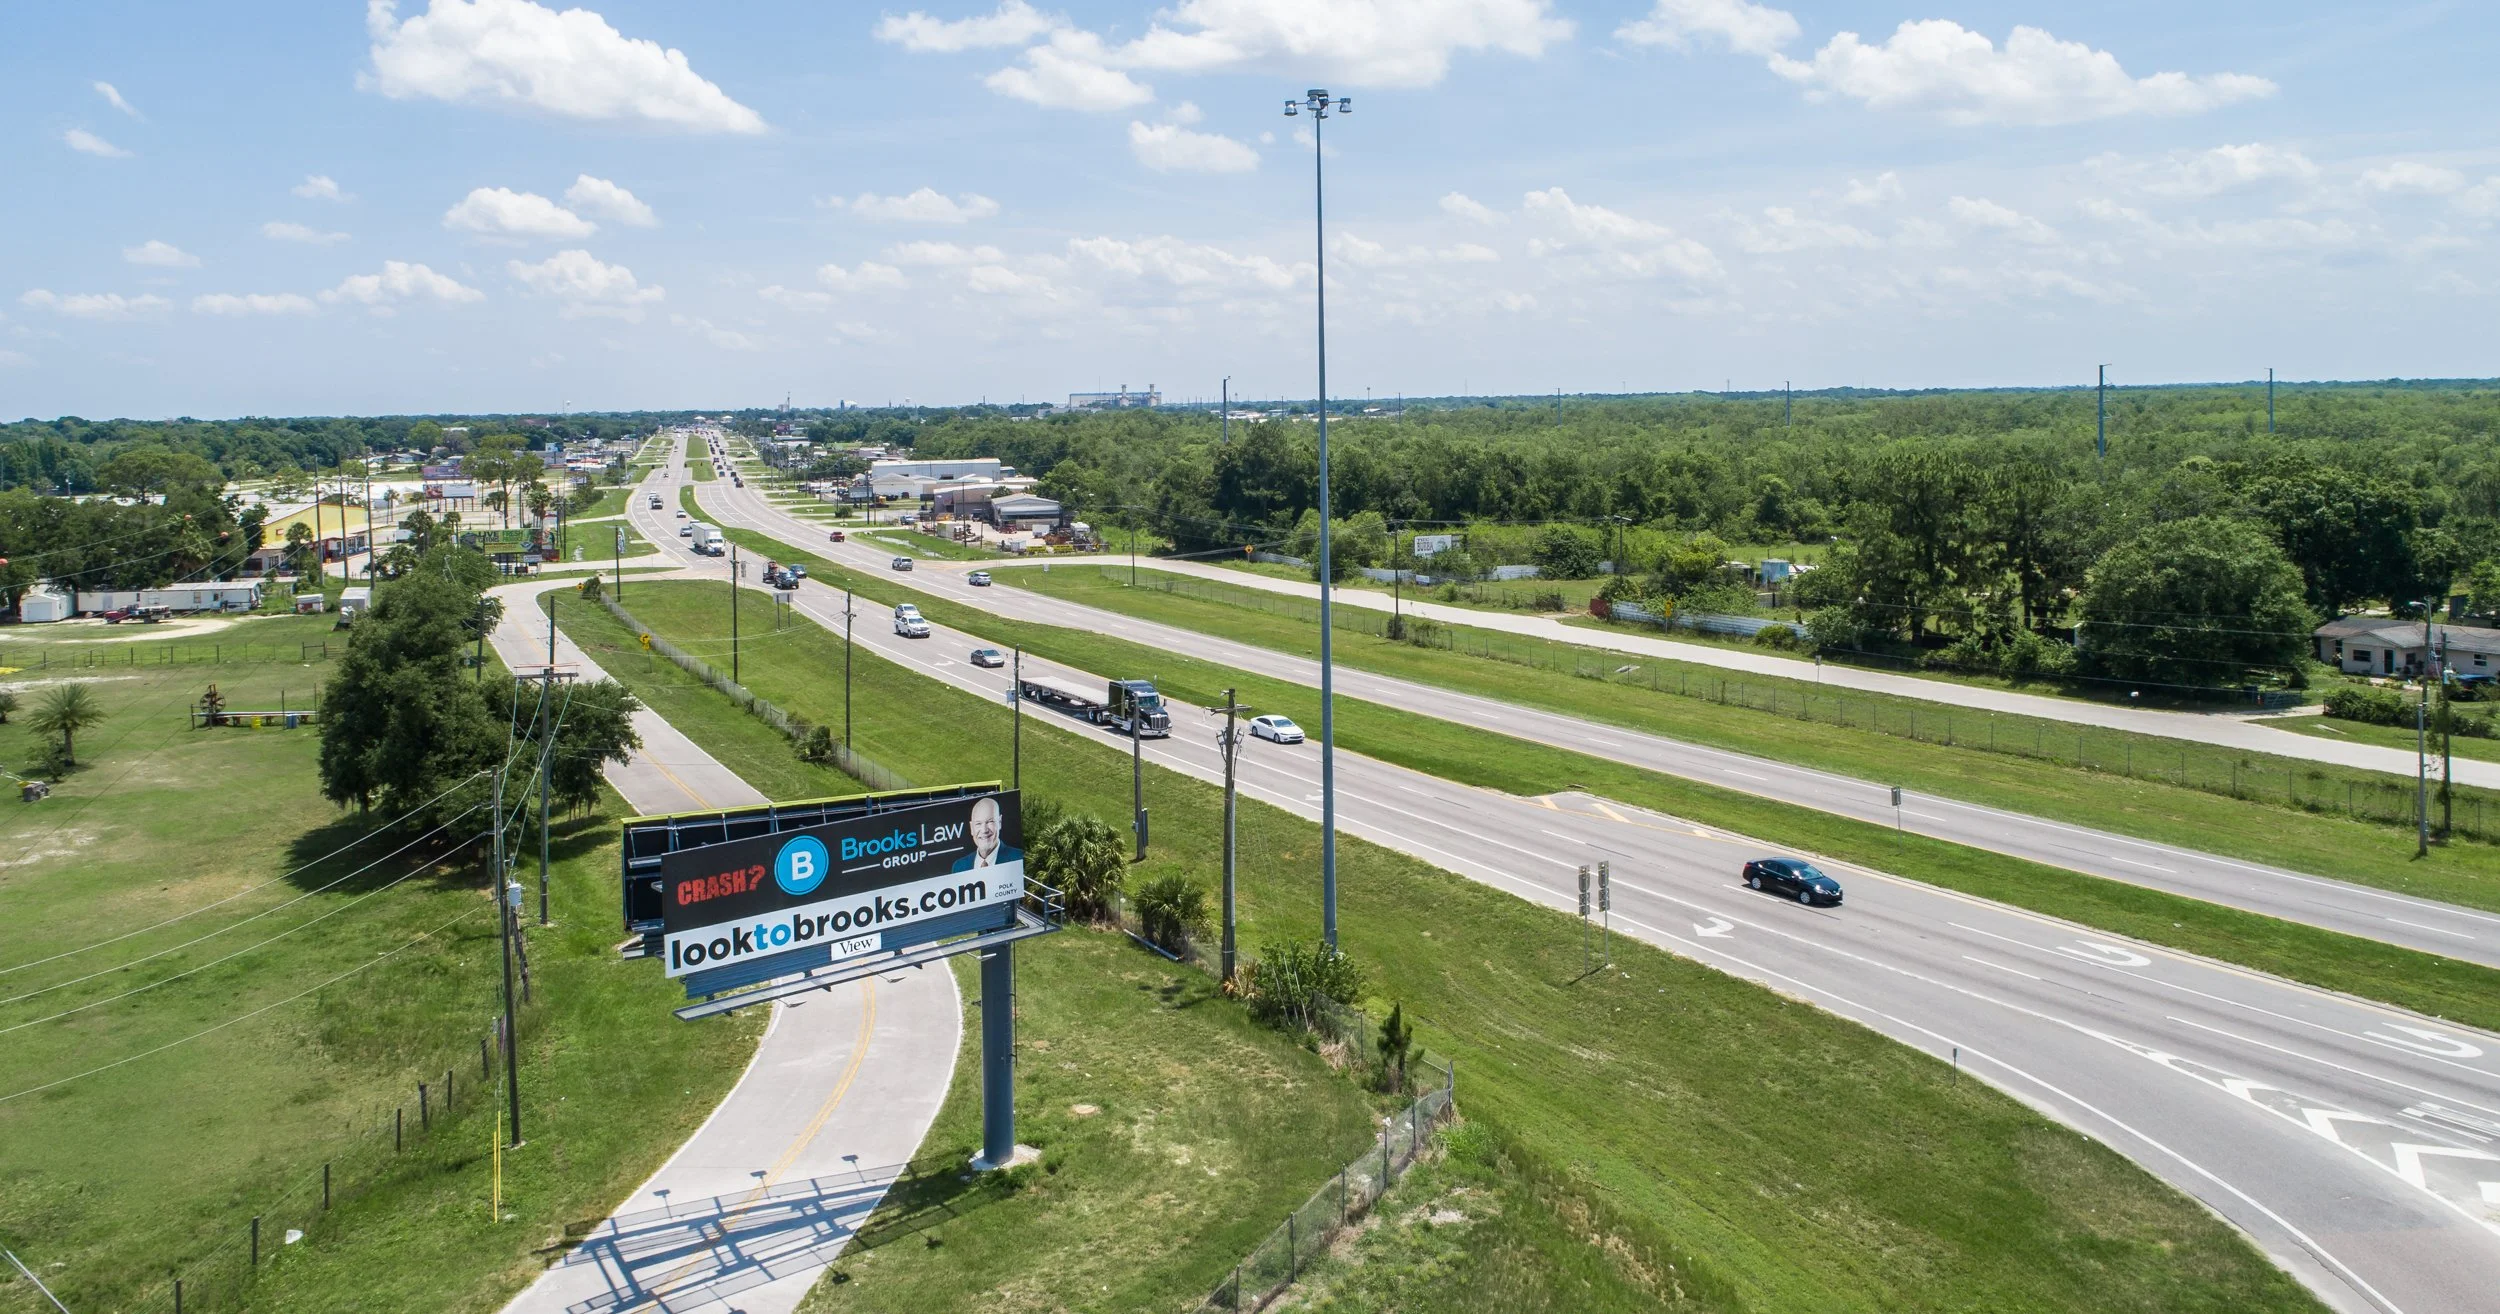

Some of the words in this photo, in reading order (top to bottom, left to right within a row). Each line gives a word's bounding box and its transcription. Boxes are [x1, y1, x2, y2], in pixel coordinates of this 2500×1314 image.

[841, 829, 917, 861] Brooks
[921, 822, 964, 846] Law
[791, 850, 815, 881] B
[882, 850, 927, 869] GROUP
[677, 864, 766, 905] CRASH?
[994, 888, 1018, 898] COUNTY
[998, 882, 1014, 890] POLK
[672, 880, 986, 970] looktobrooks.com
[840, 938, 873, 955] View
